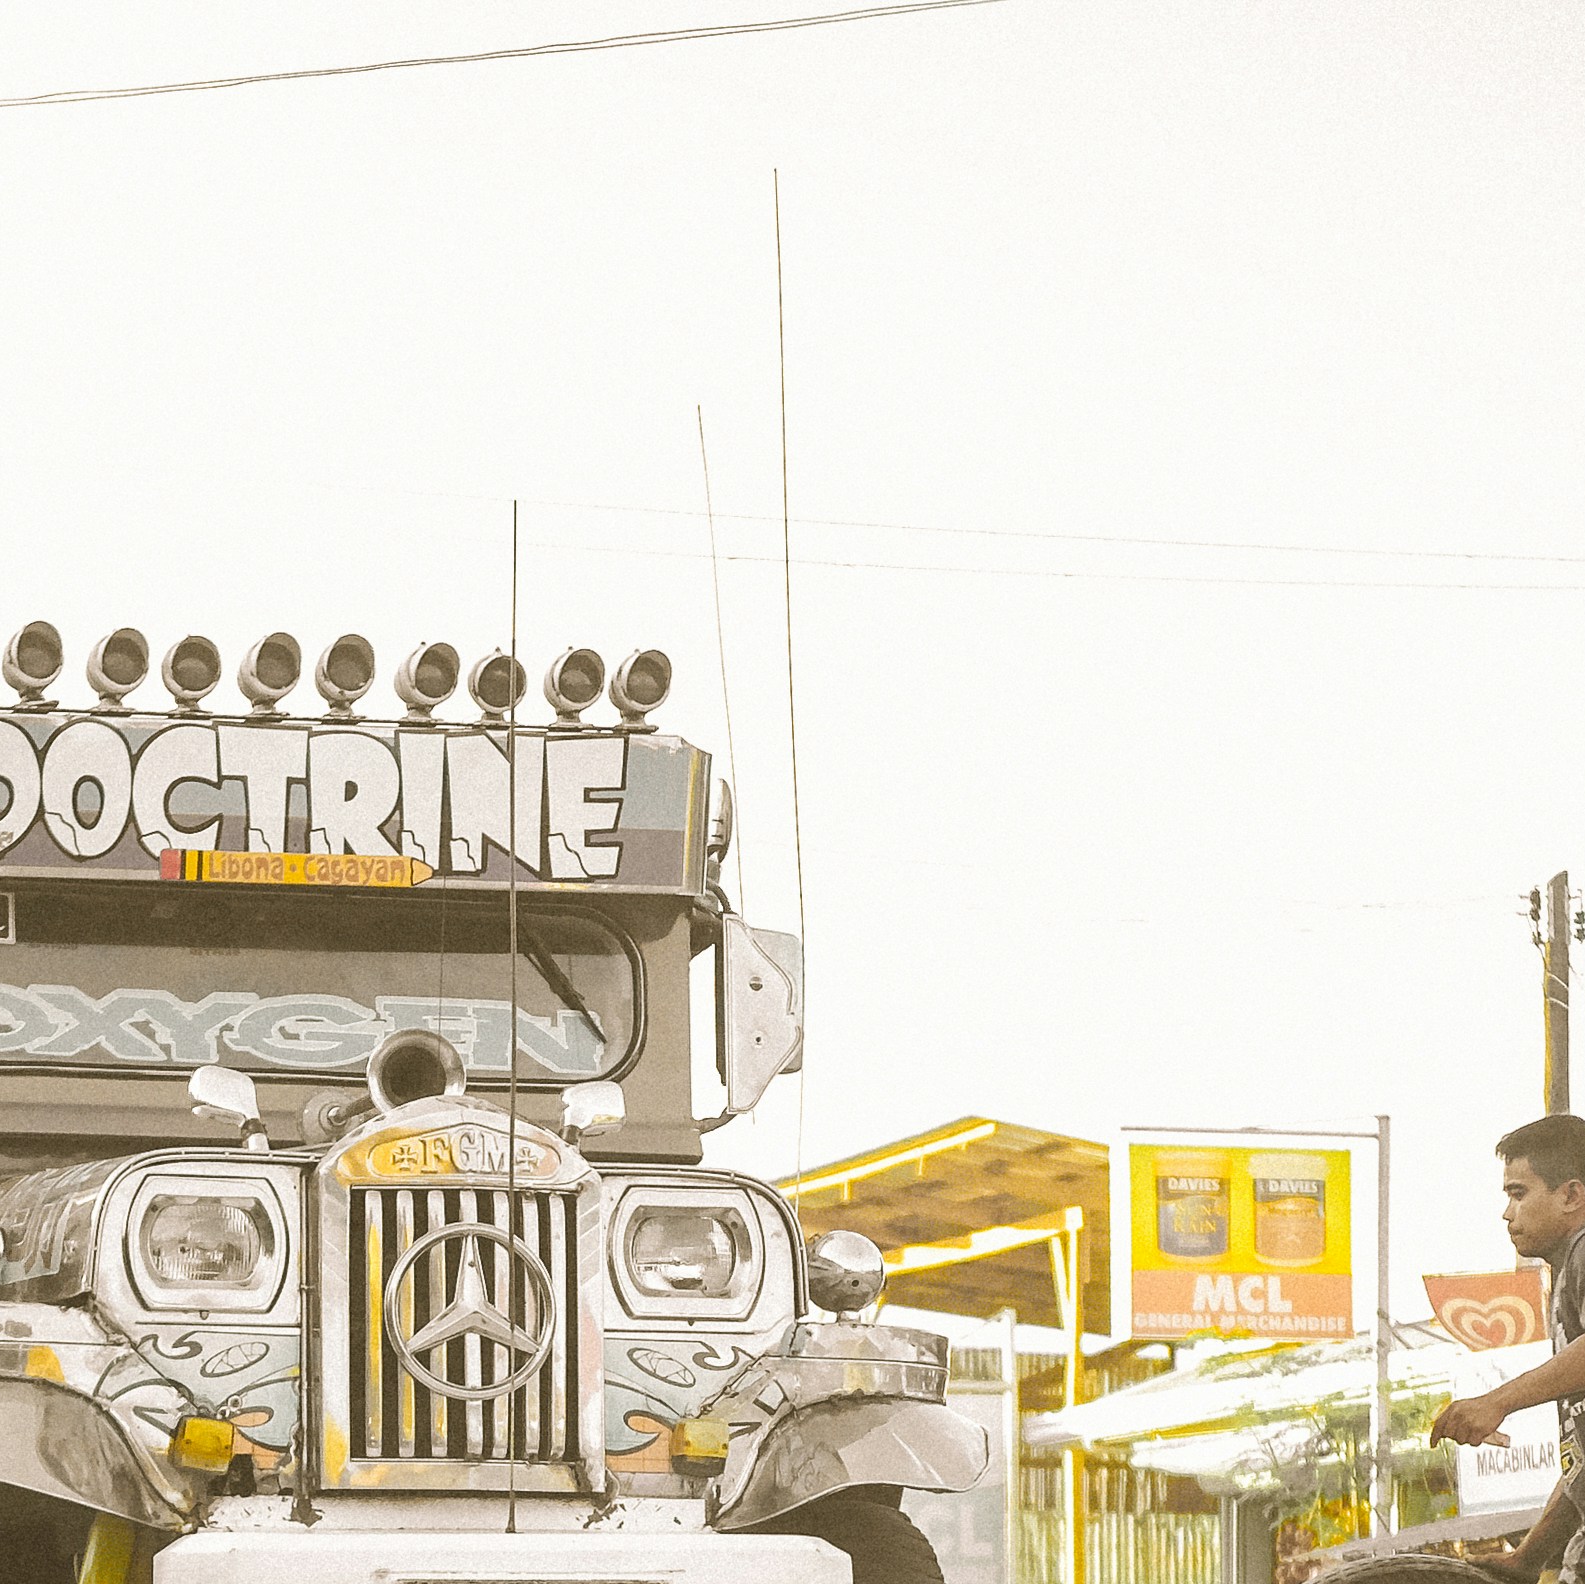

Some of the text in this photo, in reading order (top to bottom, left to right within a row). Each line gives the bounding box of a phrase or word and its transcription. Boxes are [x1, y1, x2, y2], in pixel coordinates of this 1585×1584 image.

[207, 851, 406, 884] Libona Cagayan
[419, 1127, 513, 1176] FGM
[1167, 1178, 1220, 1191] DAVIES
[1268, 1180, 1318, 1193] DAVIES
[1192, 1274, 1293, 1313] MCL
[1134, 1313, 1212, 1328] GENERAL
[1476, 1441, 1556, 1477] MACABINLAR
